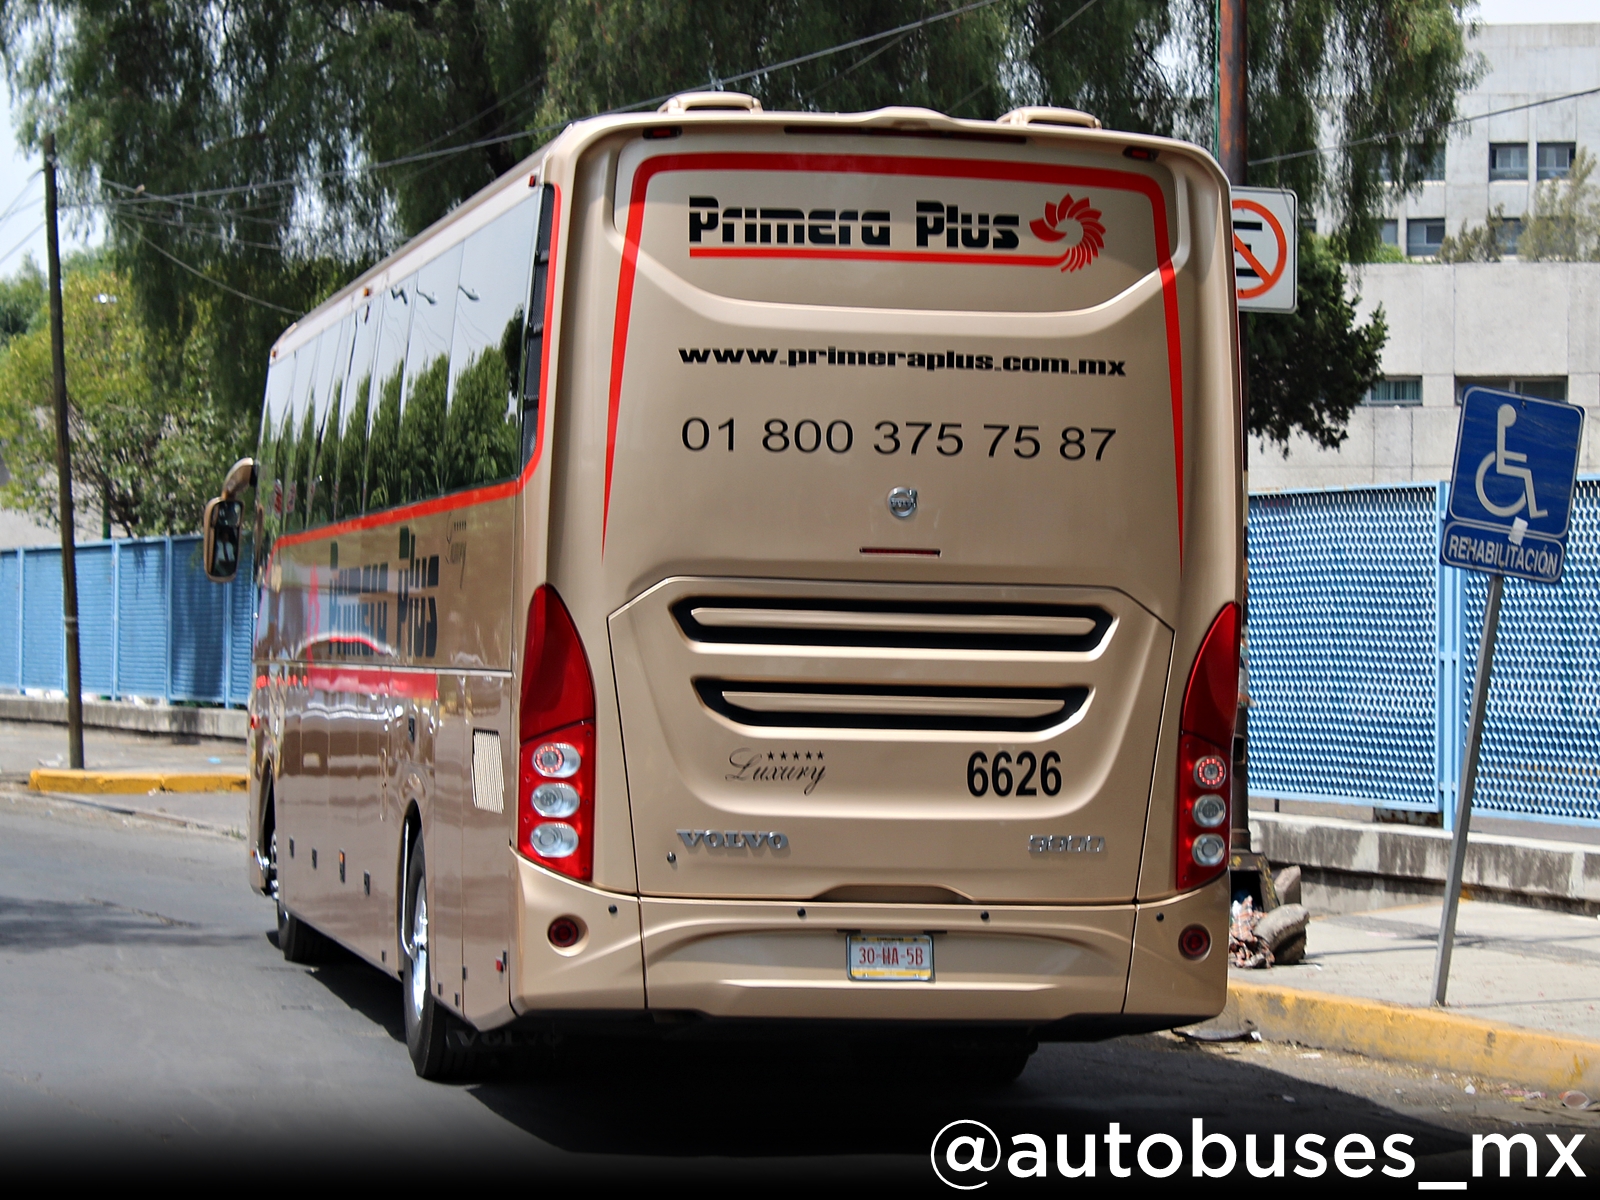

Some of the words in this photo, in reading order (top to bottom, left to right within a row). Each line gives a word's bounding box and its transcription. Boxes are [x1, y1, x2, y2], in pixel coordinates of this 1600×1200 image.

[689, 196, 891, 246] Primera
[915, 200, 1020, 250] Plus
[678, 346, 1127, 377] www.primeraplus.com.mx
[682, 417, 735, 452] 01
[762, 418, 854, 454] 800
[873, 420, 964, 457] 375
[984, 423, 1041, 460] 75
[1059, 425, 1117, 463] 87
[1448, 533, 1559, 576] REHABILITACIÓN
[725, 747, 826, 796] Luxury
[966, 750, 1062, 798] 6626
[676, 828, 789, 850] VOLVO
